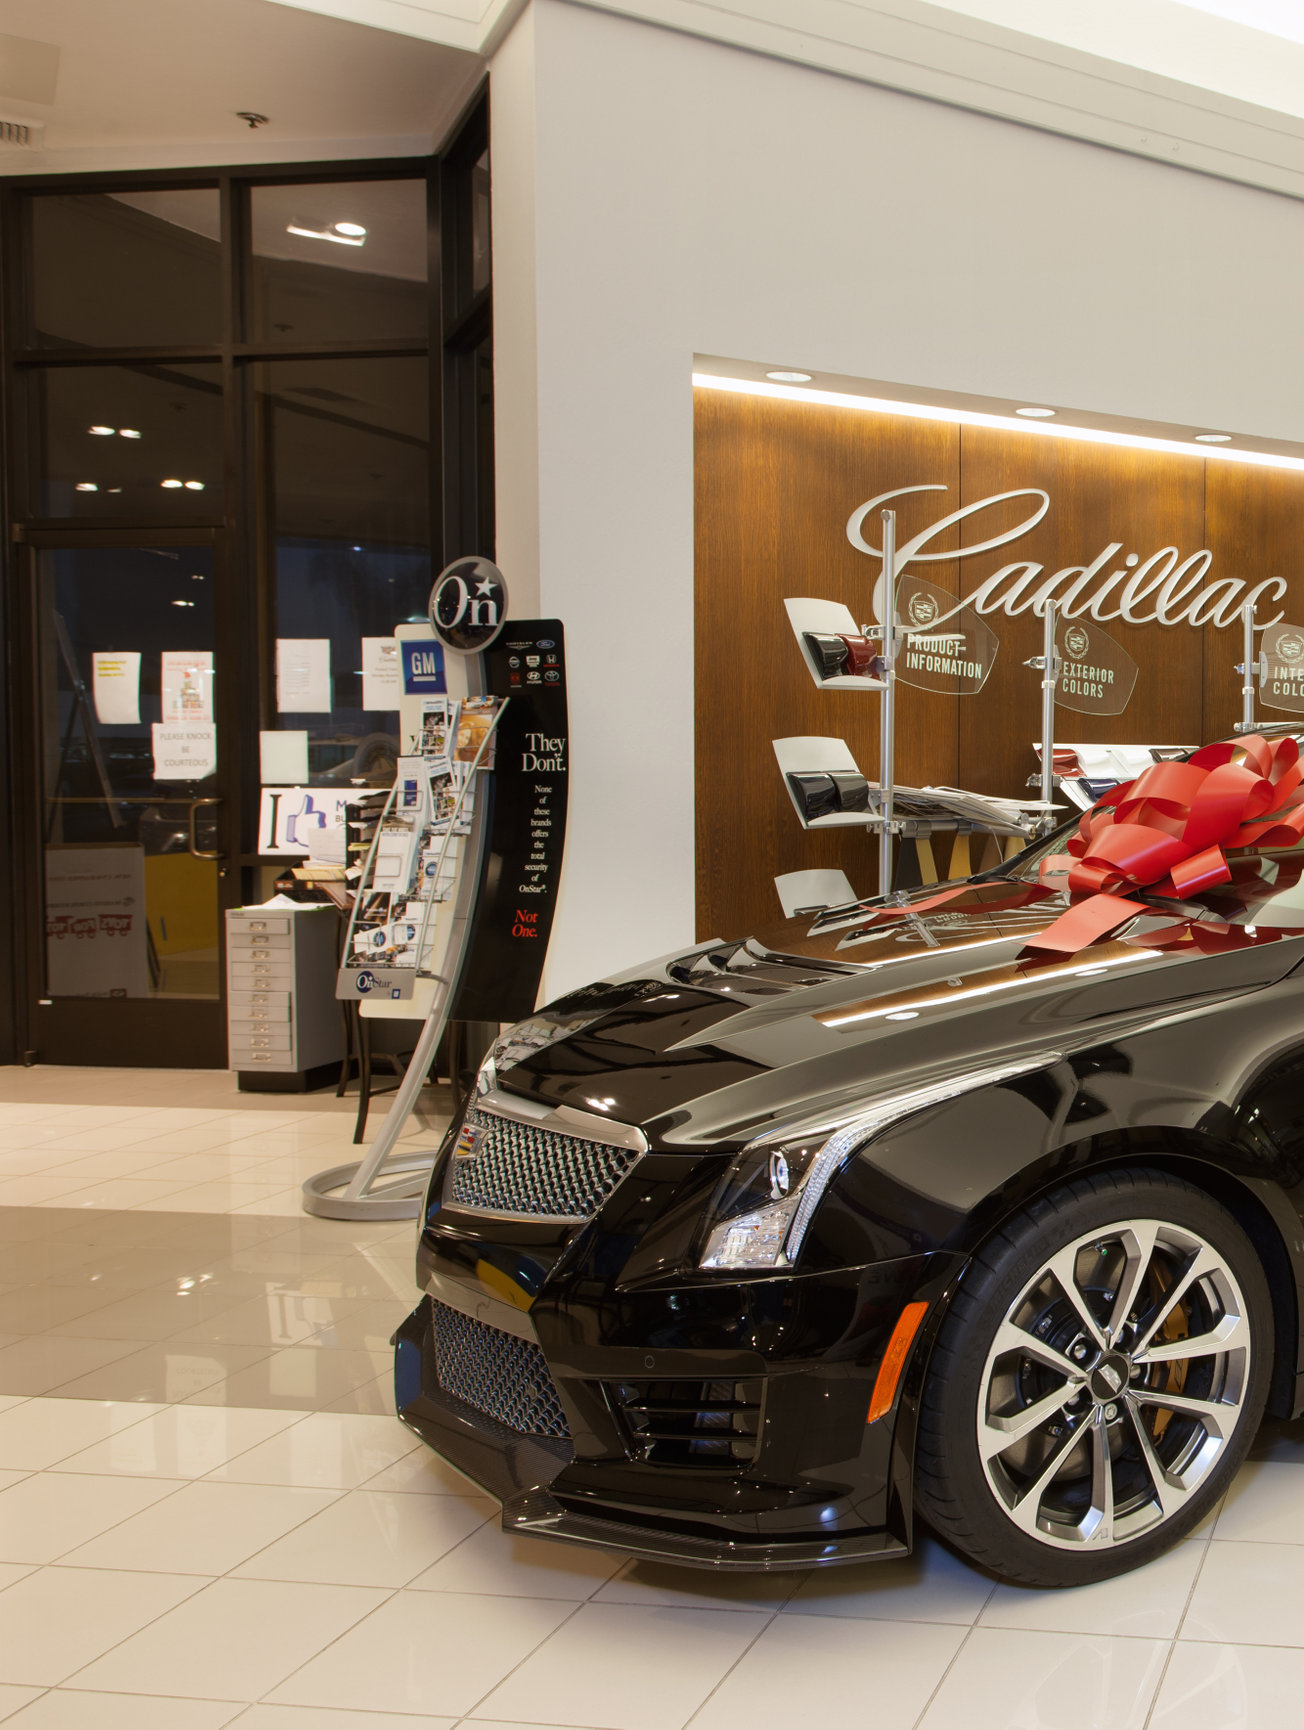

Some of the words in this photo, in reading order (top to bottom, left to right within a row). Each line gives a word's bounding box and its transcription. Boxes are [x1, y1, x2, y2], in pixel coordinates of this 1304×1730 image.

[846, 484, 1287, 632] Cadillac
[907, 632, 962, 657] PRODUCT
[411, 651, 436, 675] GM
[906, 652, 982, 679] INFORMATION
[1063, 661, 1114, 685] EXTERIOR
[1062, 678, 1104, 698] COLORS
[160, 732, 185, 741] PLEASE
[187, 732, 212, 741] KNOCK
[525, 733, 566, 756] They
[163, 758, 209, 768] COURTEOUS
[521, 752, 566, 772] Don't.
[534, 785, 553, 794] None
[539, 796, 548, 804] of
[533, 807, 551, 816] these
[530, 819, 552, 827] brands
[531, 830, 549, 838] offers
[533, 841, 545, 849] the
[530, 852, 546, 860] total
[524, 863, 548, 872] security
[531, 874, 540, 882] of
[514, 909, 539, 923] Not
[511, 924, 538, 938] One.
[356, 974, 392, 991] OnStar
